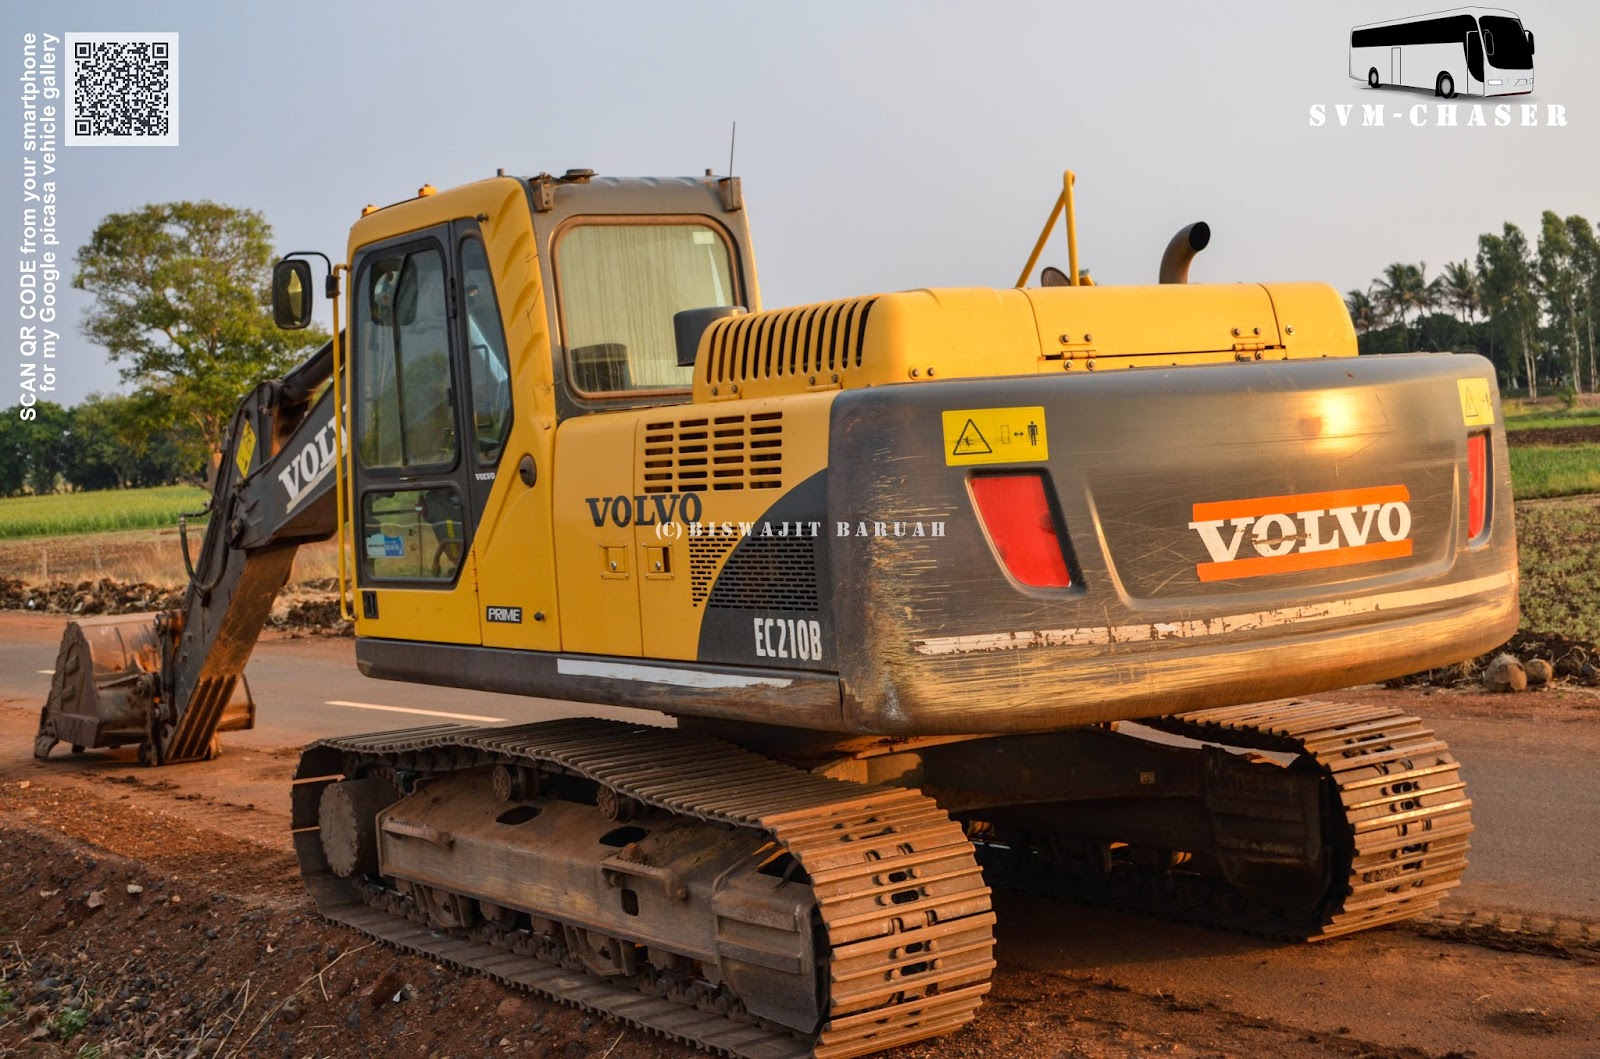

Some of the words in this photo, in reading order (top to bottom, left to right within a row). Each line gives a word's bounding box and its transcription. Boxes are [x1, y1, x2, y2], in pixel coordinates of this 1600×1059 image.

[475, 472, 496, 481] VOLVO
[585, 493, 703, 528] VOLVO
[1188, 501, 1412, 563] VOLVO
[488, 608, 521, 622] PRIME
[753, 617, 823, 661] EC210B
